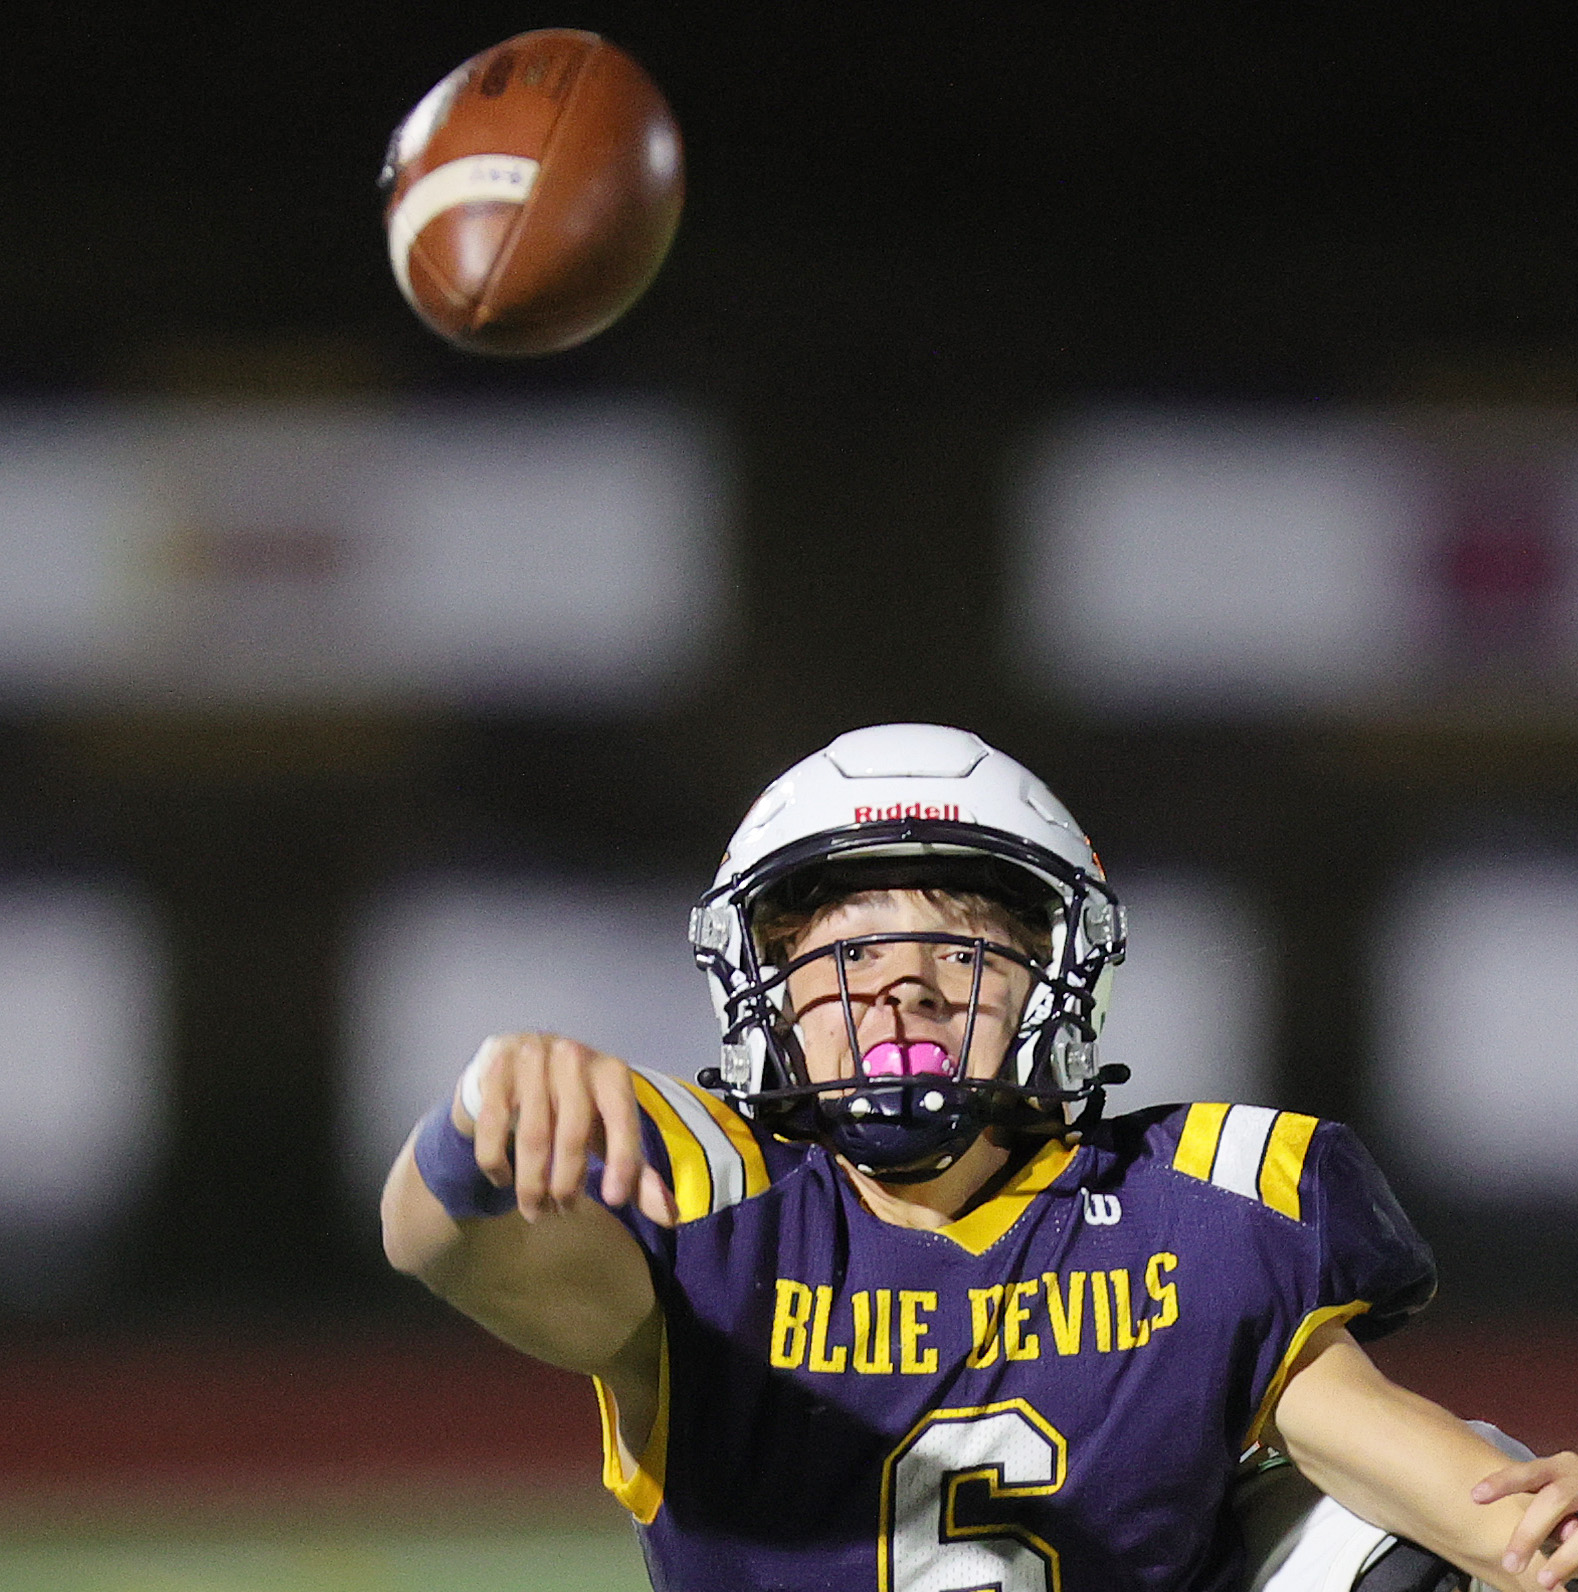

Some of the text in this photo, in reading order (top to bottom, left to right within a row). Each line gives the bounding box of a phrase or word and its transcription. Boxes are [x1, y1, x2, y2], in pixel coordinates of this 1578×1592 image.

[854, 802, 959, 823] Riddell
[769, 1251, 1179, 1375] BLUE DEVILS
